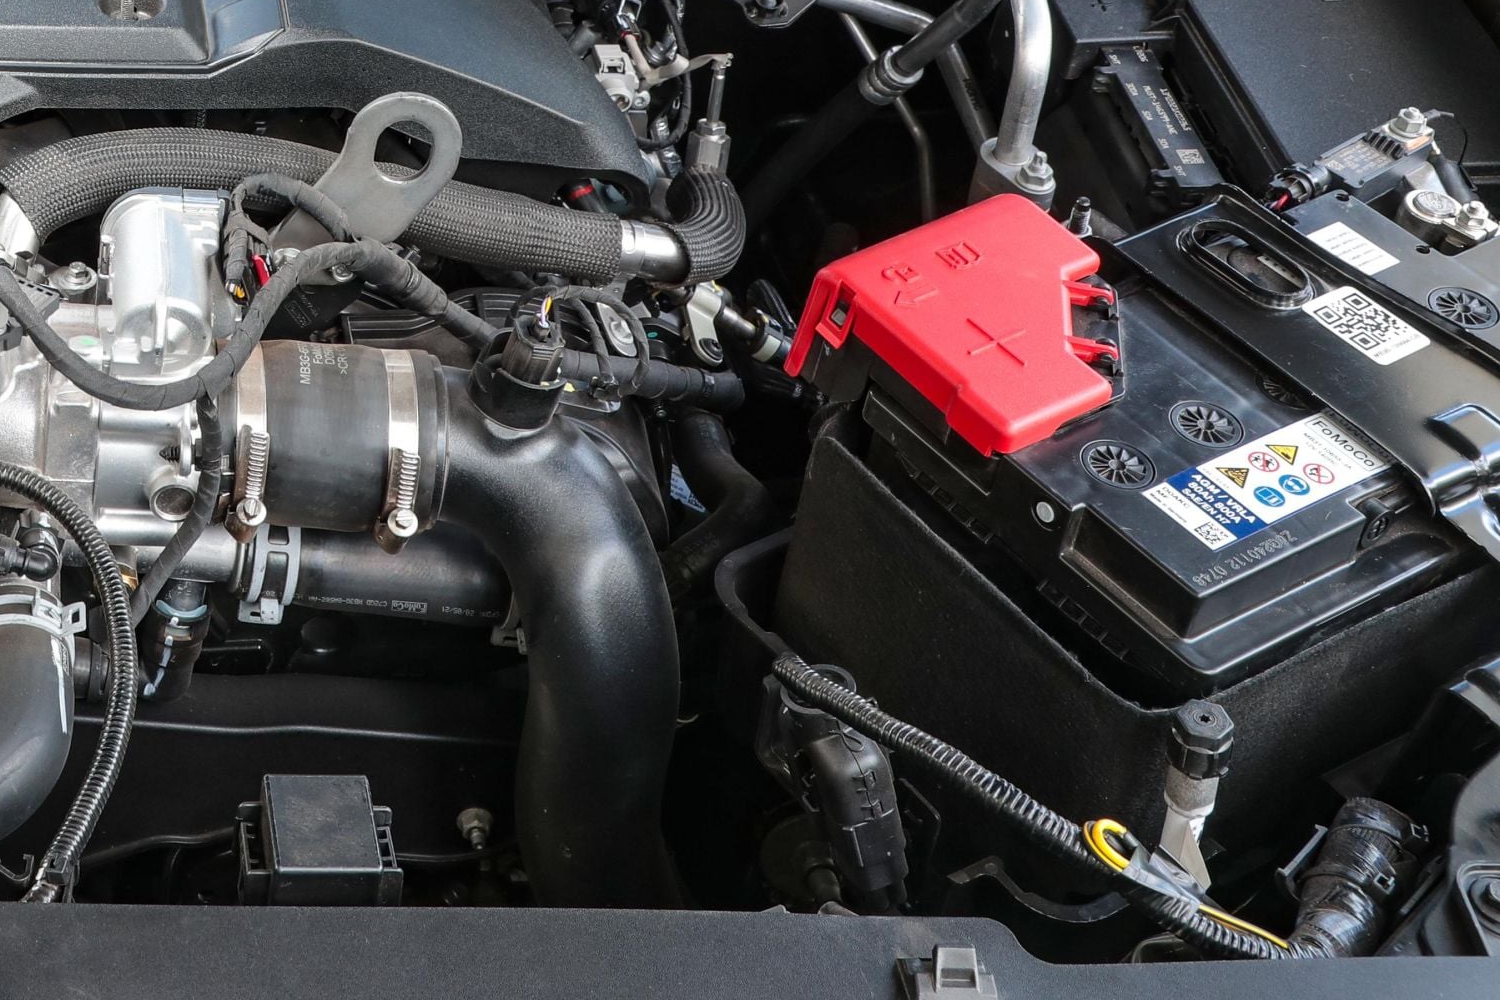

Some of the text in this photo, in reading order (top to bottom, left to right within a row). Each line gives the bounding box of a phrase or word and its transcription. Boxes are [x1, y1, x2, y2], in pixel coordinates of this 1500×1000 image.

[1312, 420, 1375, 467] FoMoCo
[1181, 488, 1217, 515] SAE/EN
[1188, 481, 1241, 524] 80Ah 800A
[1191, 474, 1221, 493] AGM
[1226, 498, 1257, 524] VRLA
[391, 600, 428, 613] FoMoCo
